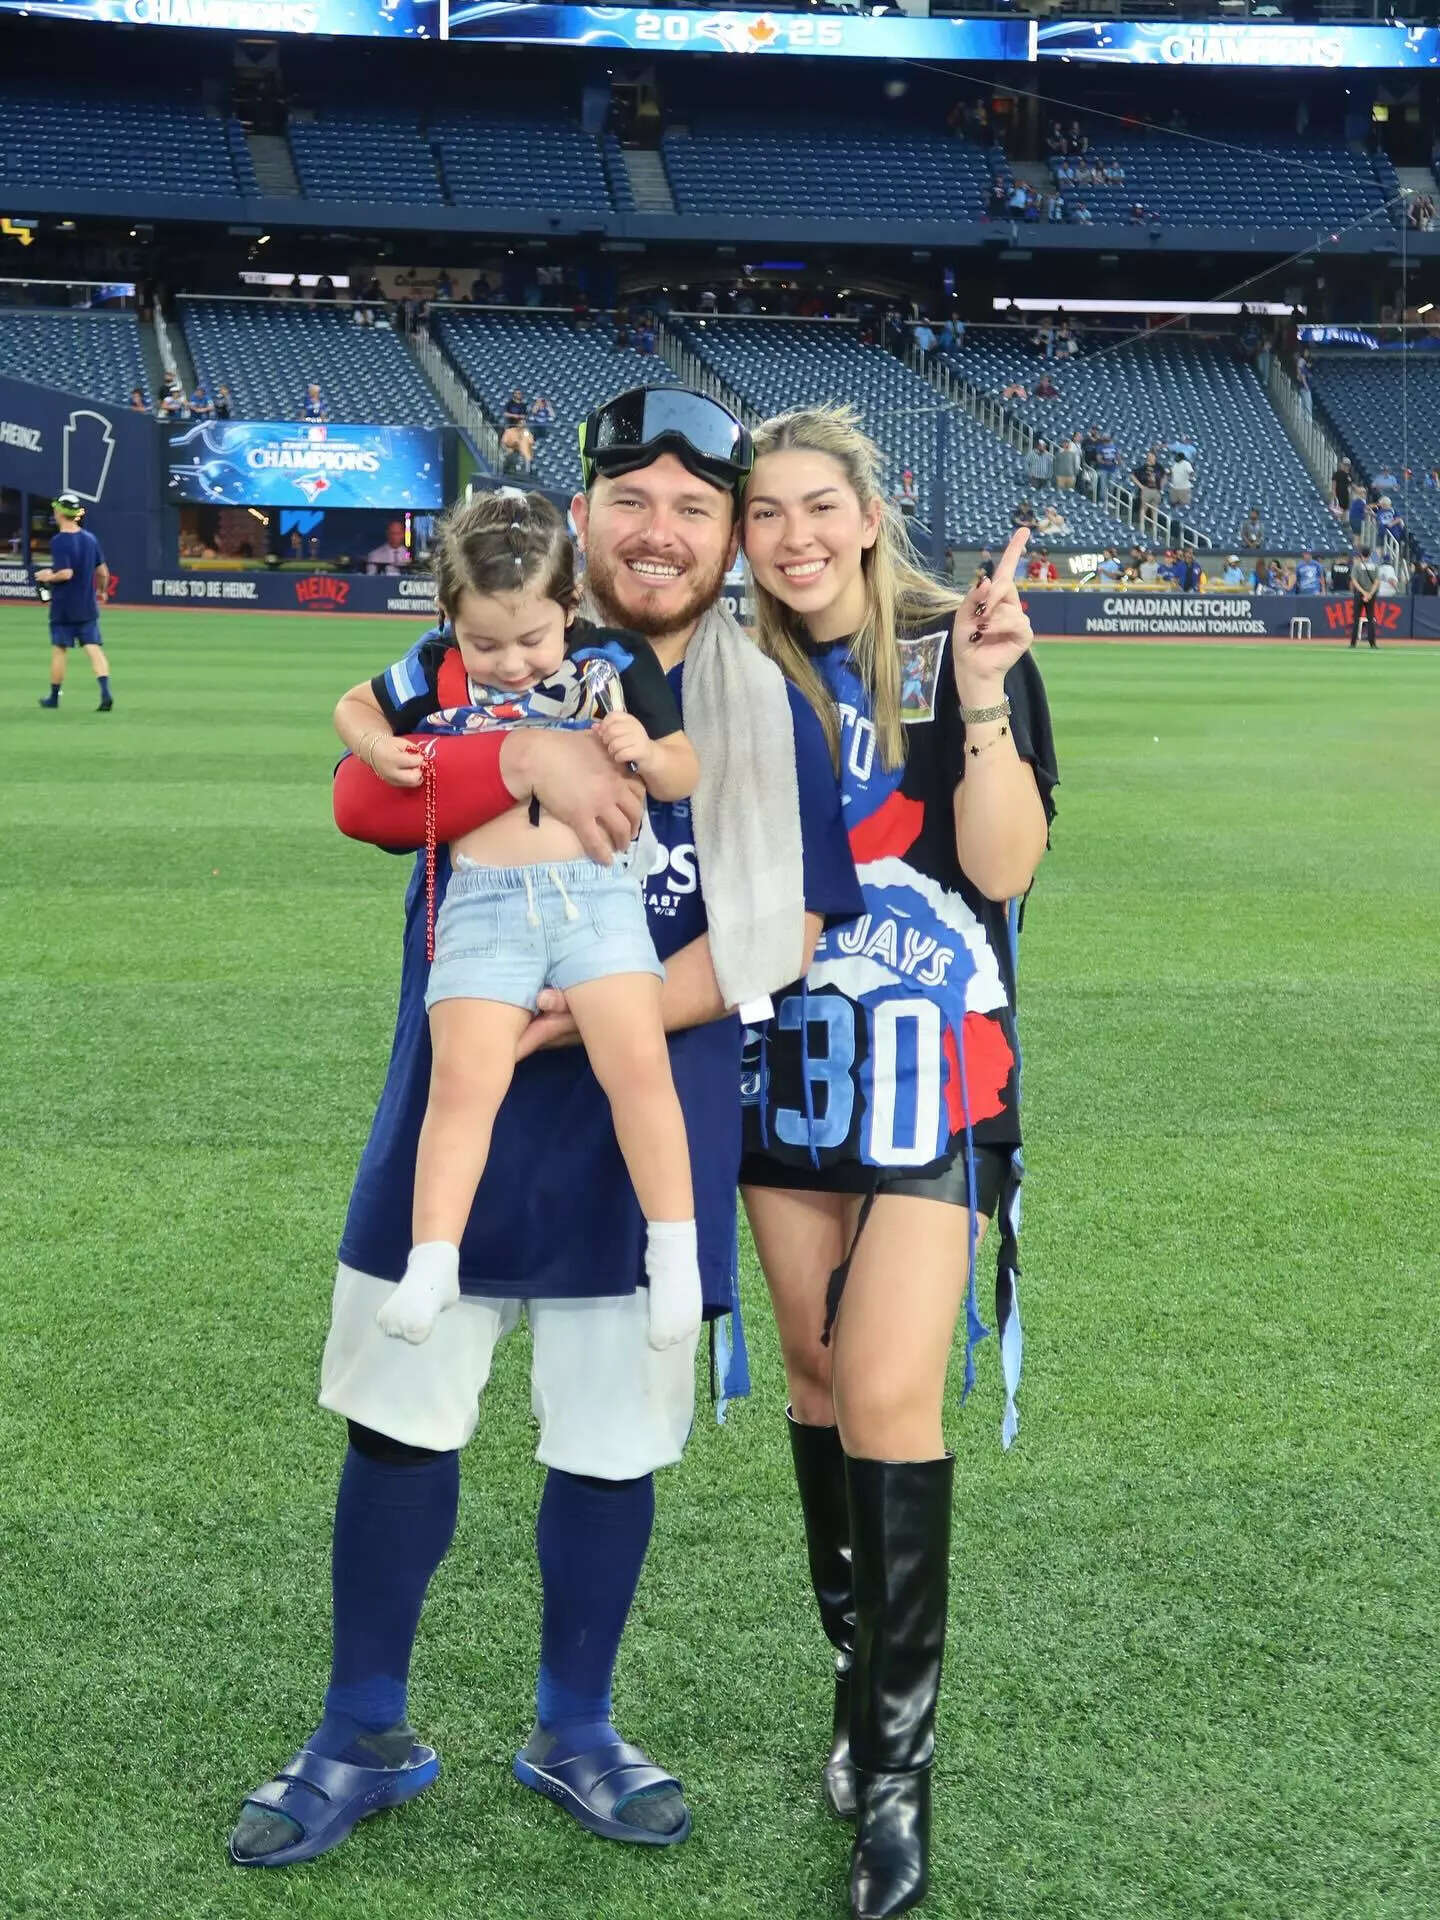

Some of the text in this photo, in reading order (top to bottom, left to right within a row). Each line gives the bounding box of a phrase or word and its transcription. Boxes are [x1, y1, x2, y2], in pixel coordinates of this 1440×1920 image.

[635, 14, 844, 46] 20 25
[246, 448, 381, 472] CHAMPIONS
[152, 579, 164, 596] IT
[164, 579, 188, 597] HAS
[188, 580, 206, 598] TO
[206, 581, 222, 598] BE
[295, 576, 350, 605] HEINZ
[1103, 598, 1182, 617] CANADIAN
[1086, 618, 1119, 632] MADE
[1119, 619, 1149, 633] WITH
[1149, 619, 1207, 633] CANADIAN
[838, 912, 954, 987] JAYS
[775, 995, 941, 1168] 30
